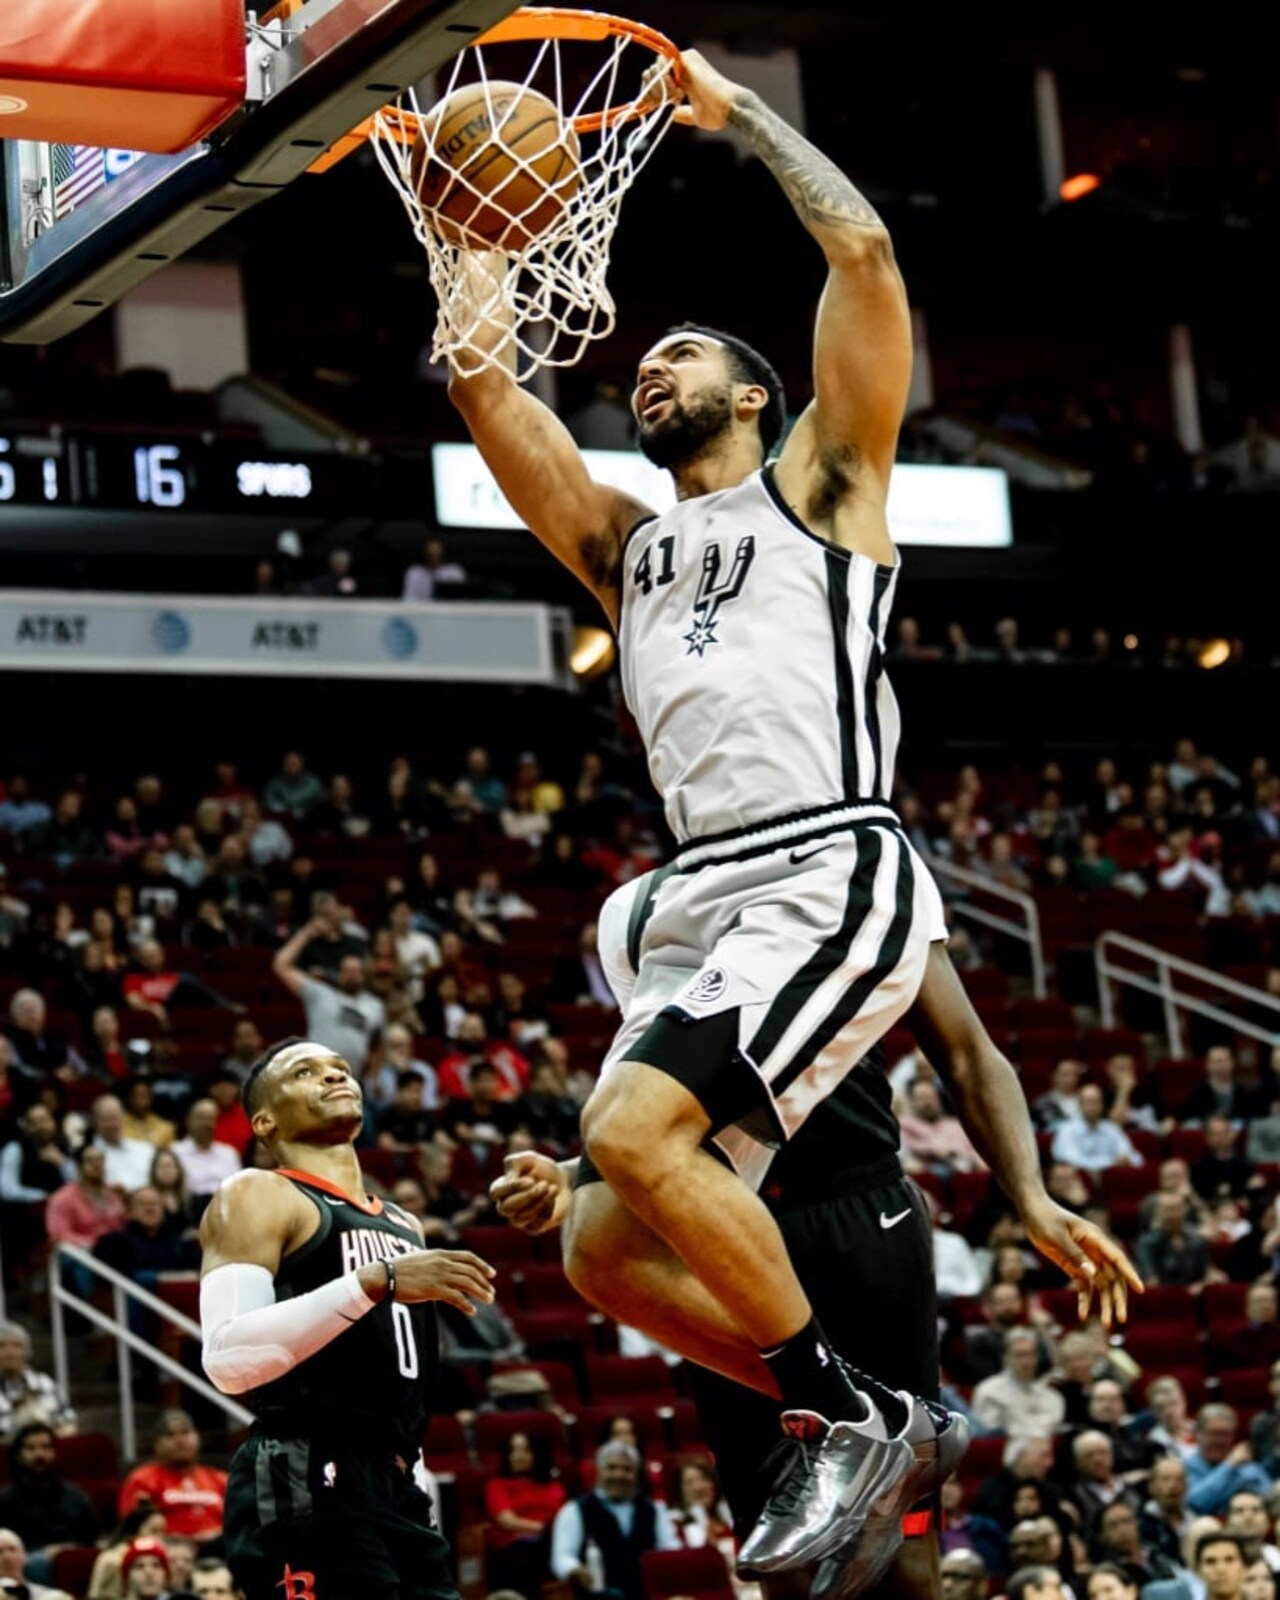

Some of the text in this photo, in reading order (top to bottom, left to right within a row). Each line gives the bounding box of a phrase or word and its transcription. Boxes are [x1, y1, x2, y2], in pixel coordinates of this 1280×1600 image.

[134, 445, 185, 506] 16
[634, 535, 676, 596] 41
[16, 615, 87, 645] AT&T
[252, 622, 320, 650] AT&T
[340, 1229, 418, 1276] HOUST
[392, 1302, 418, 1379] 0
